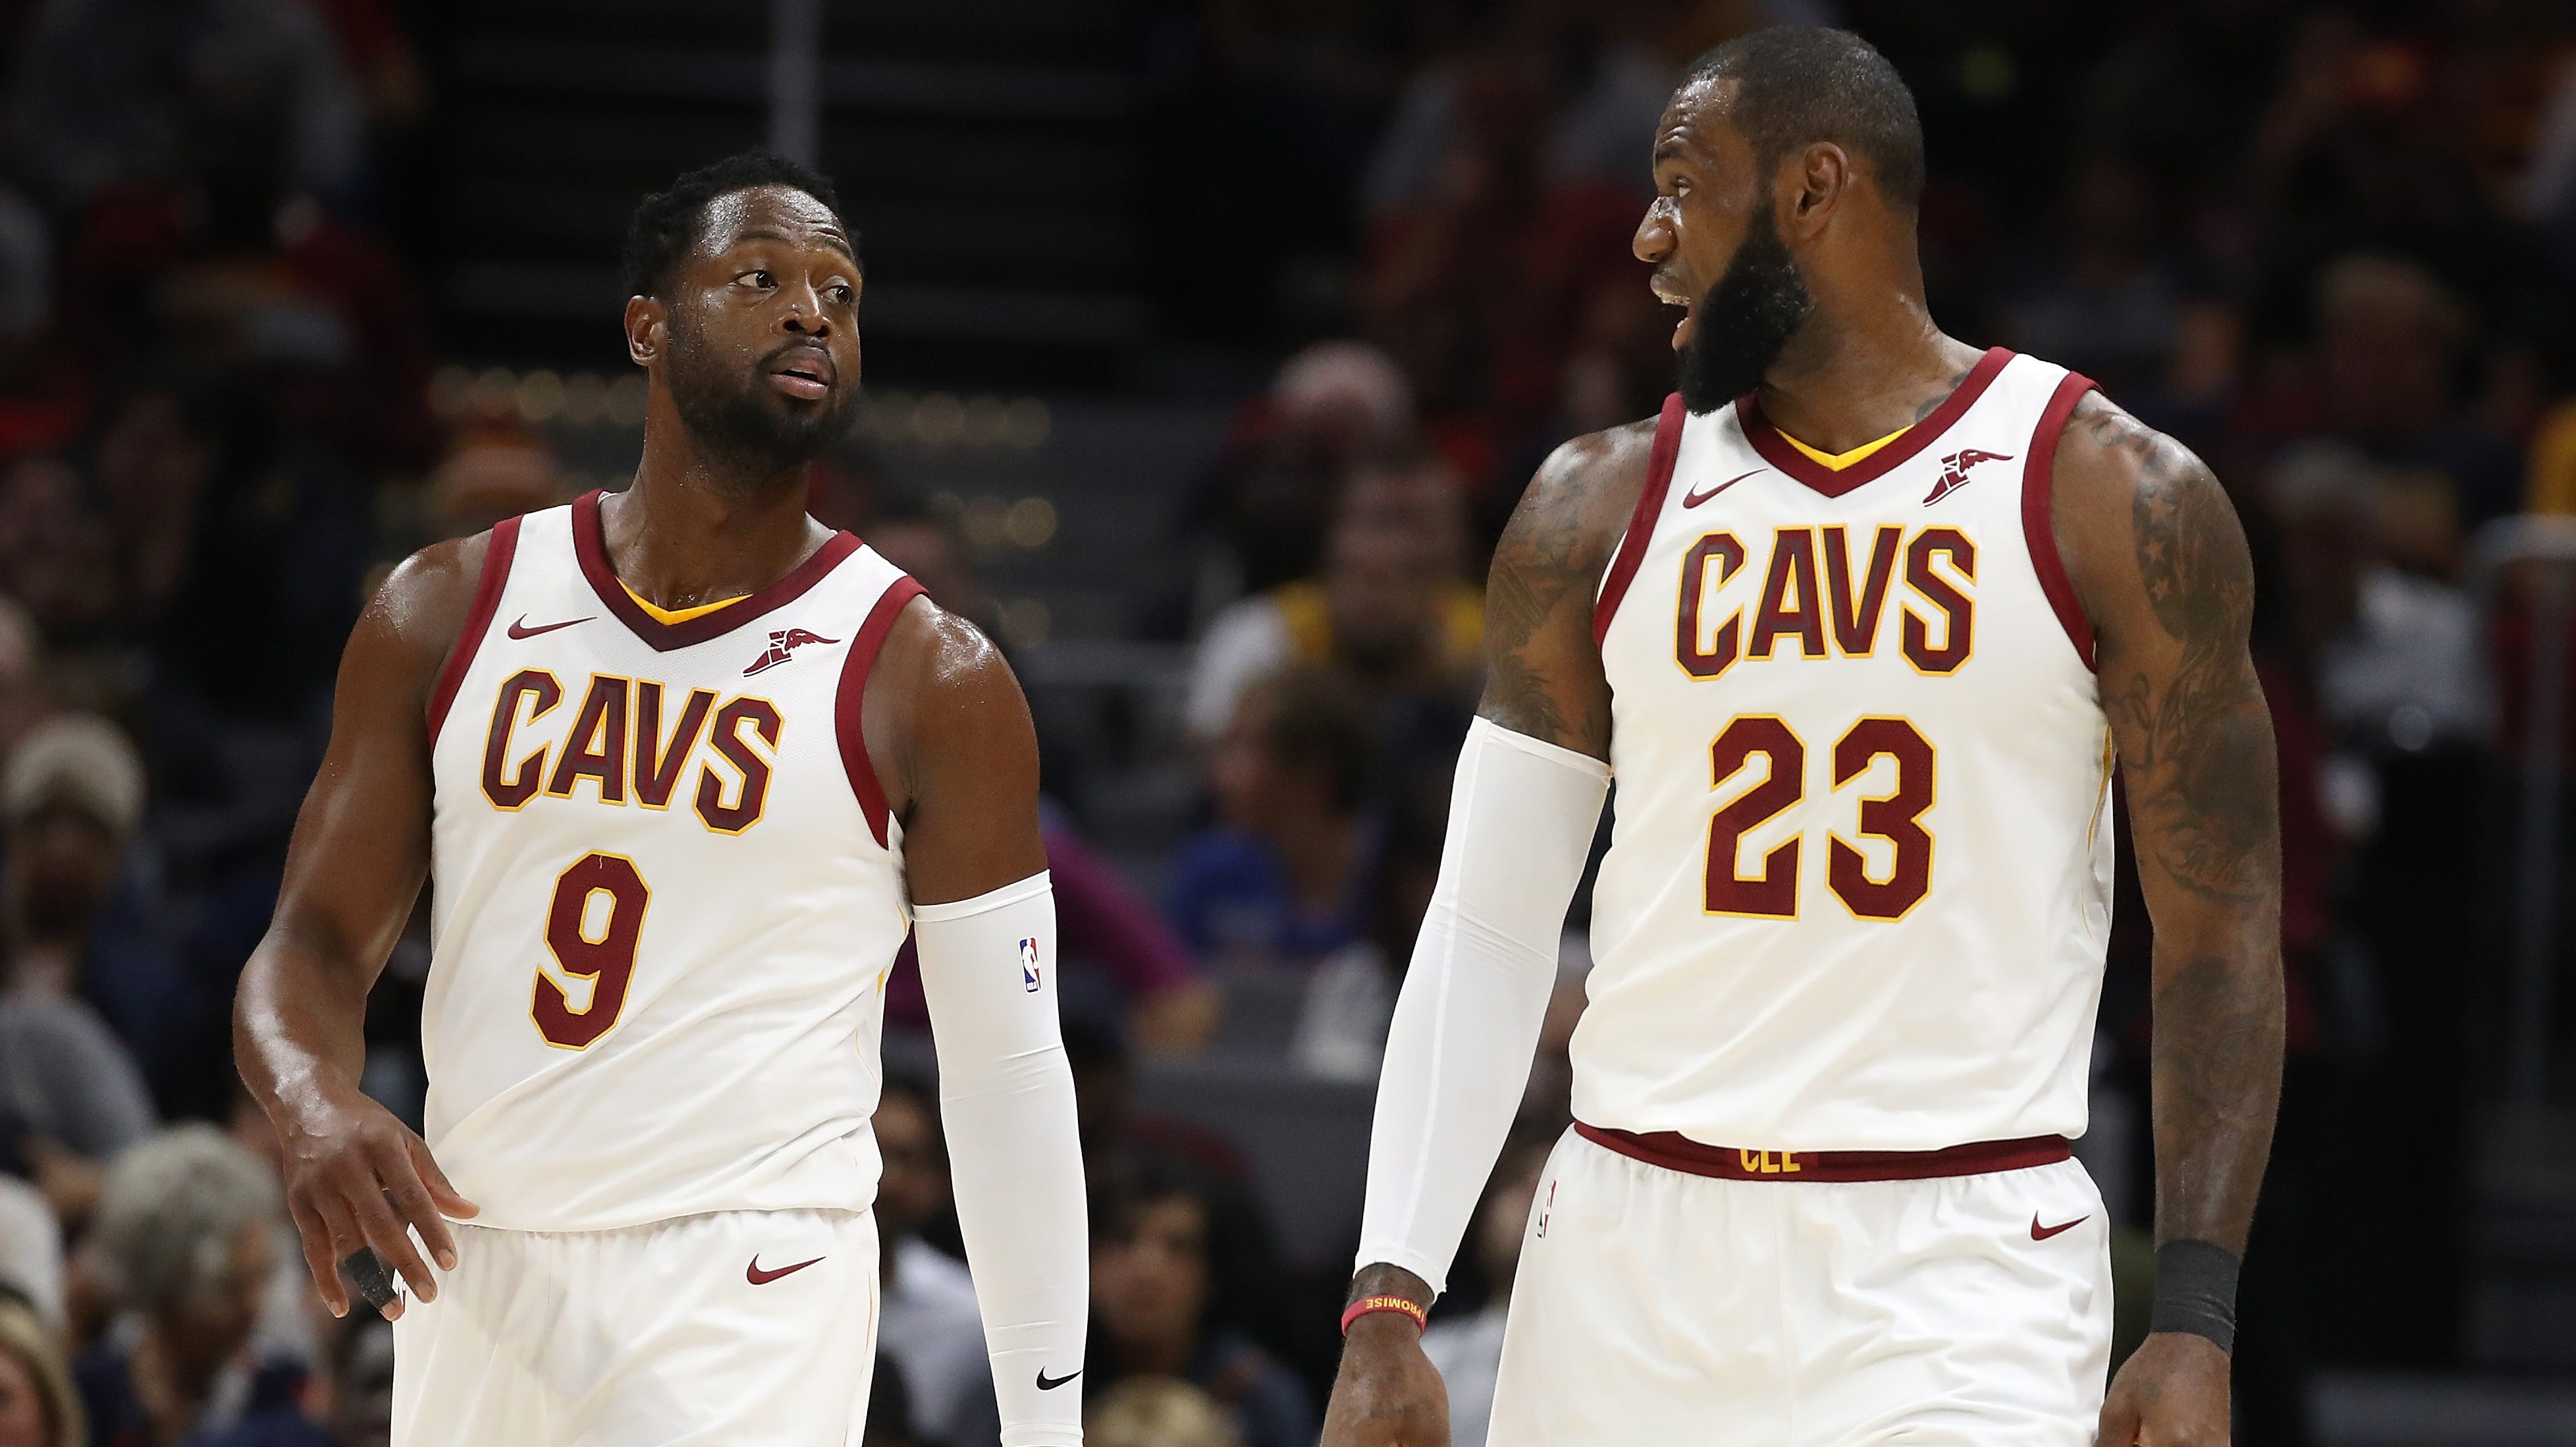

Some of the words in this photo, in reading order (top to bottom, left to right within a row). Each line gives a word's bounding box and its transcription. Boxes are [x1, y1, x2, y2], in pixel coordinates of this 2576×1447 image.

[1673, 522, 1978, 682] CAVS
[479, 667, 786, 836] CAVS
[1702, 713, 1938, 923] 23
[529, 849, 652, 1051] 9
[1366, 1297, 1421, 1319] PROMISE
